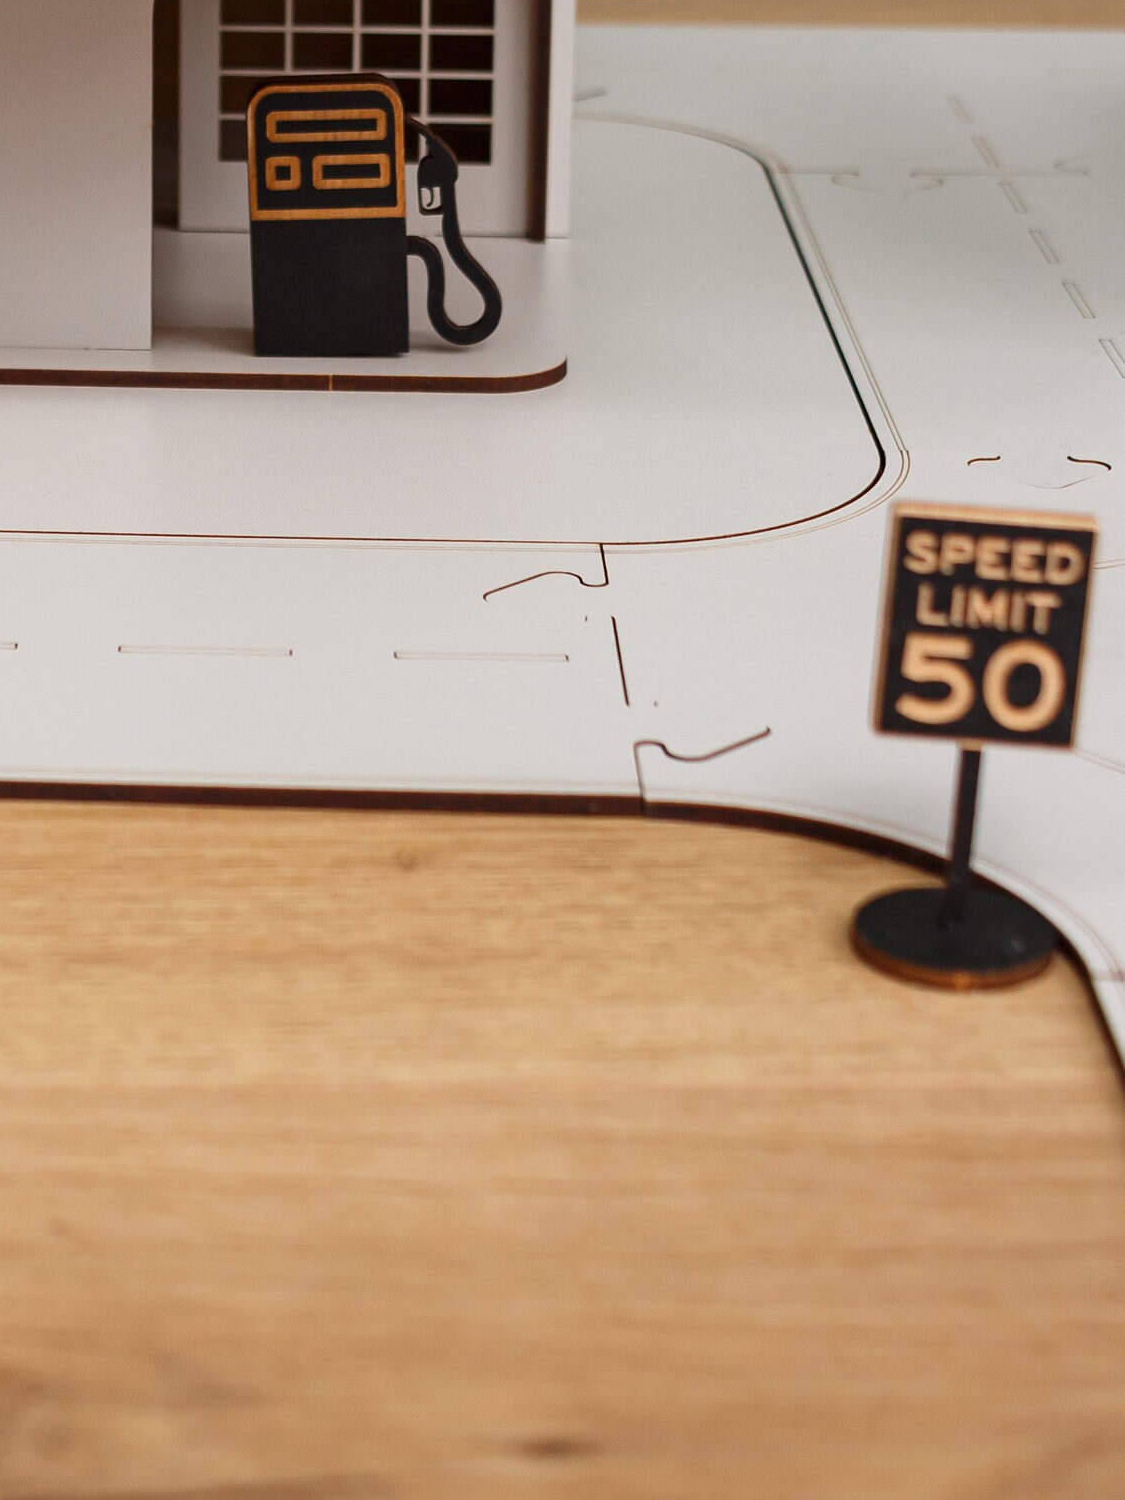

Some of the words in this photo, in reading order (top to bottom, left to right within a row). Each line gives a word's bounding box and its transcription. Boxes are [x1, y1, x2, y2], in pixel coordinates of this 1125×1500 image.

[902, 528, 1086, 586] SPEED
[915, 579, 1063, 636] LIMIT
[894, 631, 1068, 733] 50
